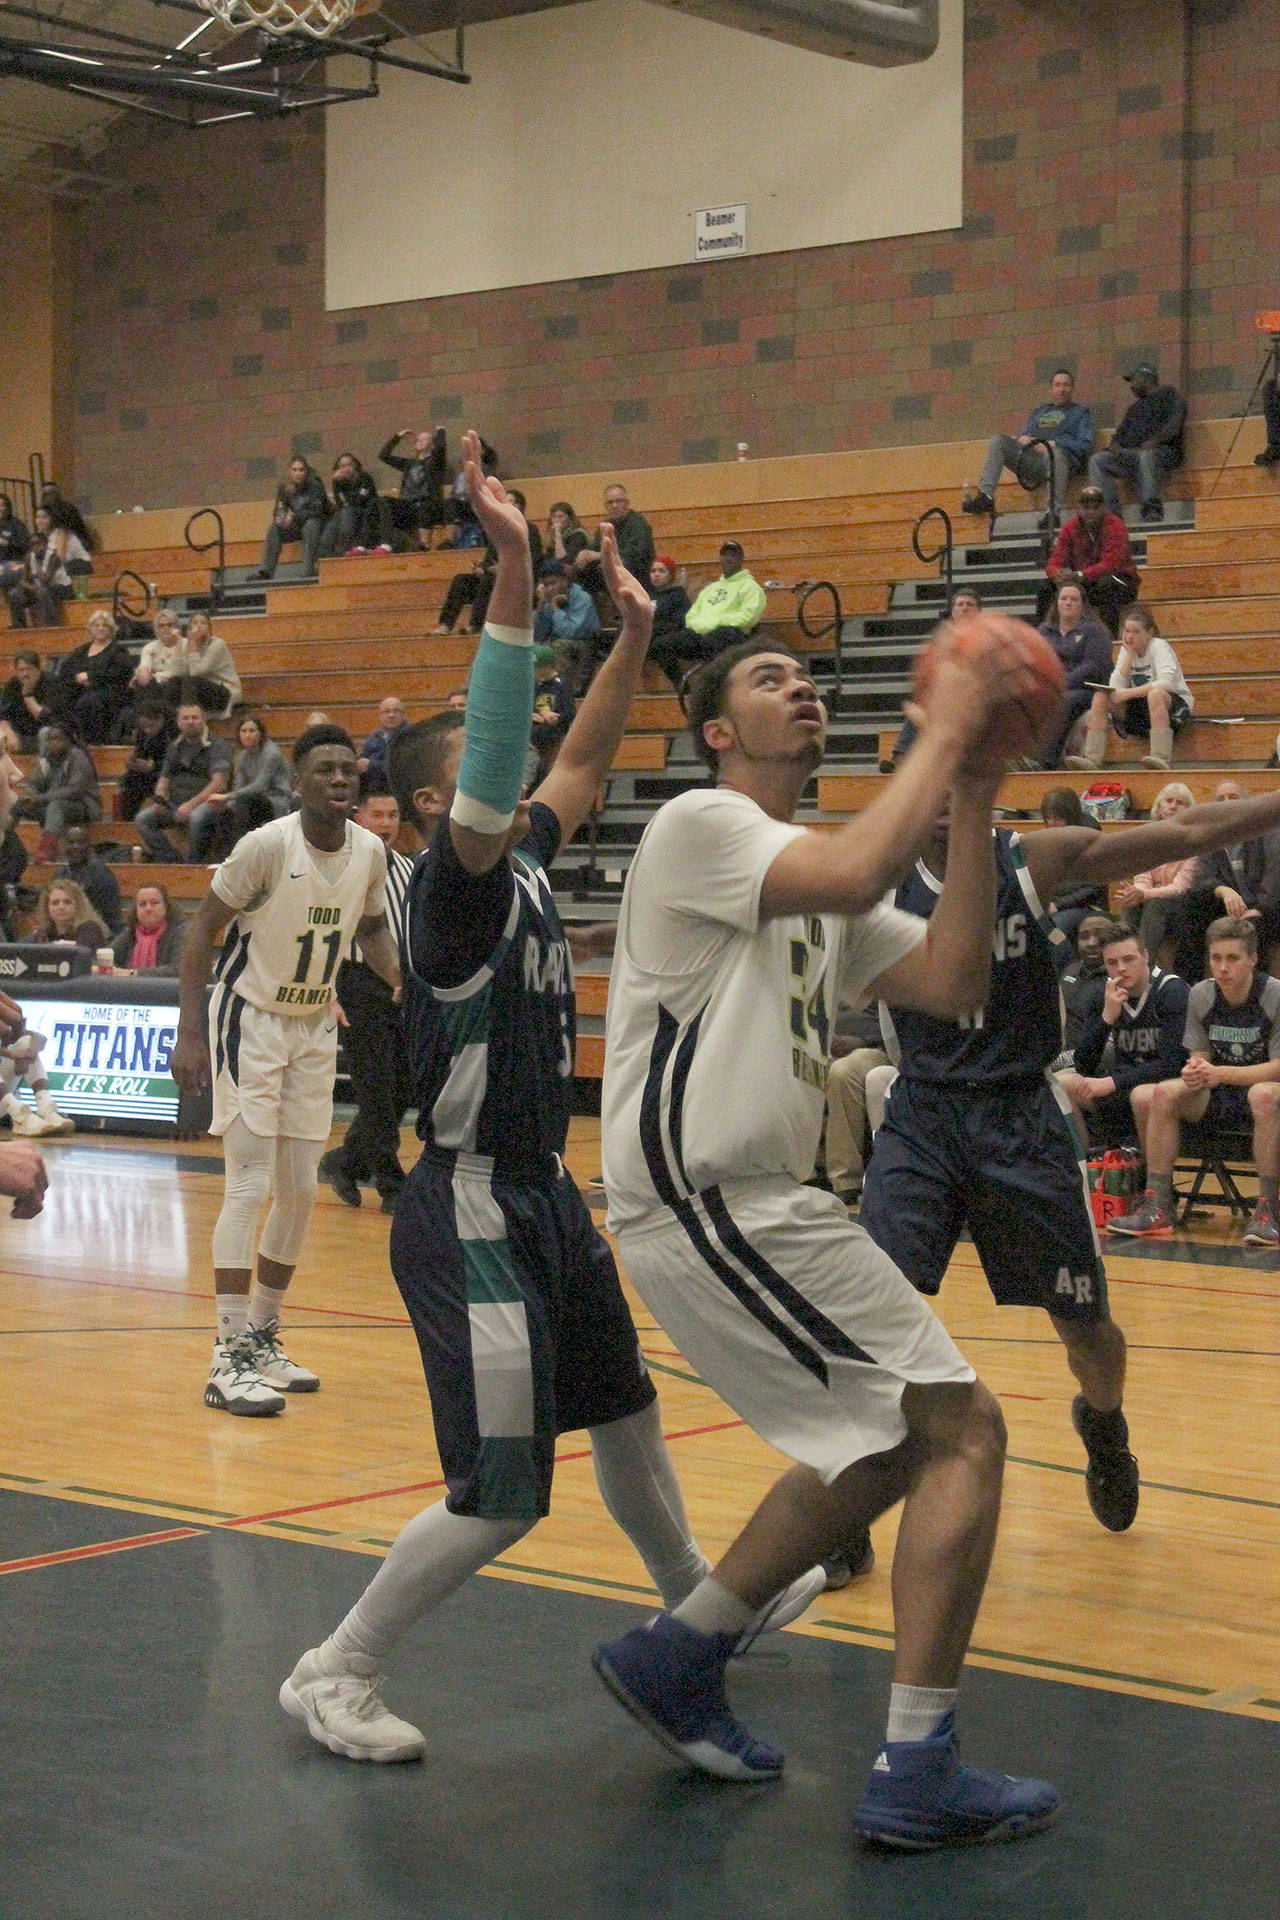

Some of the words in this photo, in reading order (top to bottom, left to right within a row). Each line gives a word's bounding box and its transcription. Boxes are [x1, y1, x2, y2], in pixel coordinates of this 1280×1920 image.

[705, 212, 736, 227] Beamer
[697, 232, 743, 251] Community
[307, 906, 341, 925] TODD
[292, 928, 342, 985] 11
[83, 1006, 113, 1022] HOME
[116, 1007, 130, 1022] OF
[132, 1008, 152, 1023] THE
[52, 1022, 178, 1073] TITANS
[63, 1074, 108, 1094] LET'S
[108, 1077, 150, 1096] ROLL
[1103, 1200, 1115, 1219] R
[1055, 1266, 1094, 1304] AR
